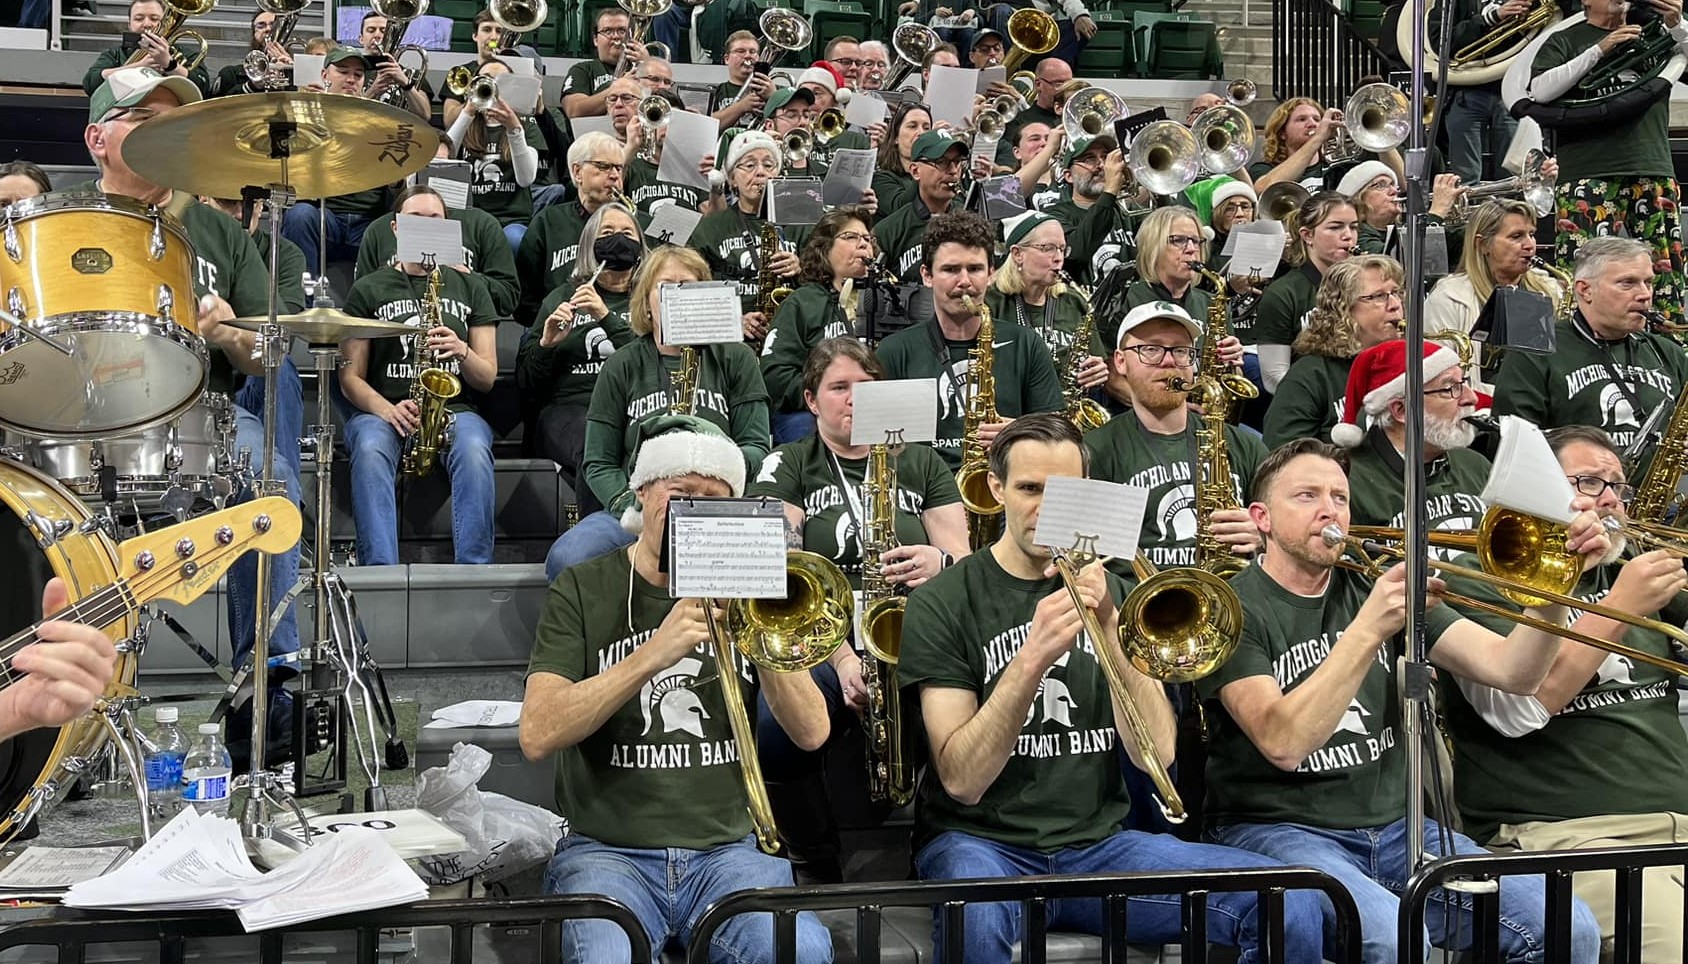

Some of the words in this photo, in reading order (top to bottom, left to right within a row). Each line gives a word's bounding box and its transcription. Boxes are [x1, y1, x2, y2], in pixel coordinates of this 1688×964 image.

[632, 184, 668, 204] MICHIGAN
[550, 244, 578, 272] MICH
[900, 244, 923, 277] MICH
[610, 743, 692, 769] ALUMNI
[700, 739, 740, 767] BAN
[1010, 732, 1062, 759] UMNI
[1067, 727, 1116, 755] BAND
